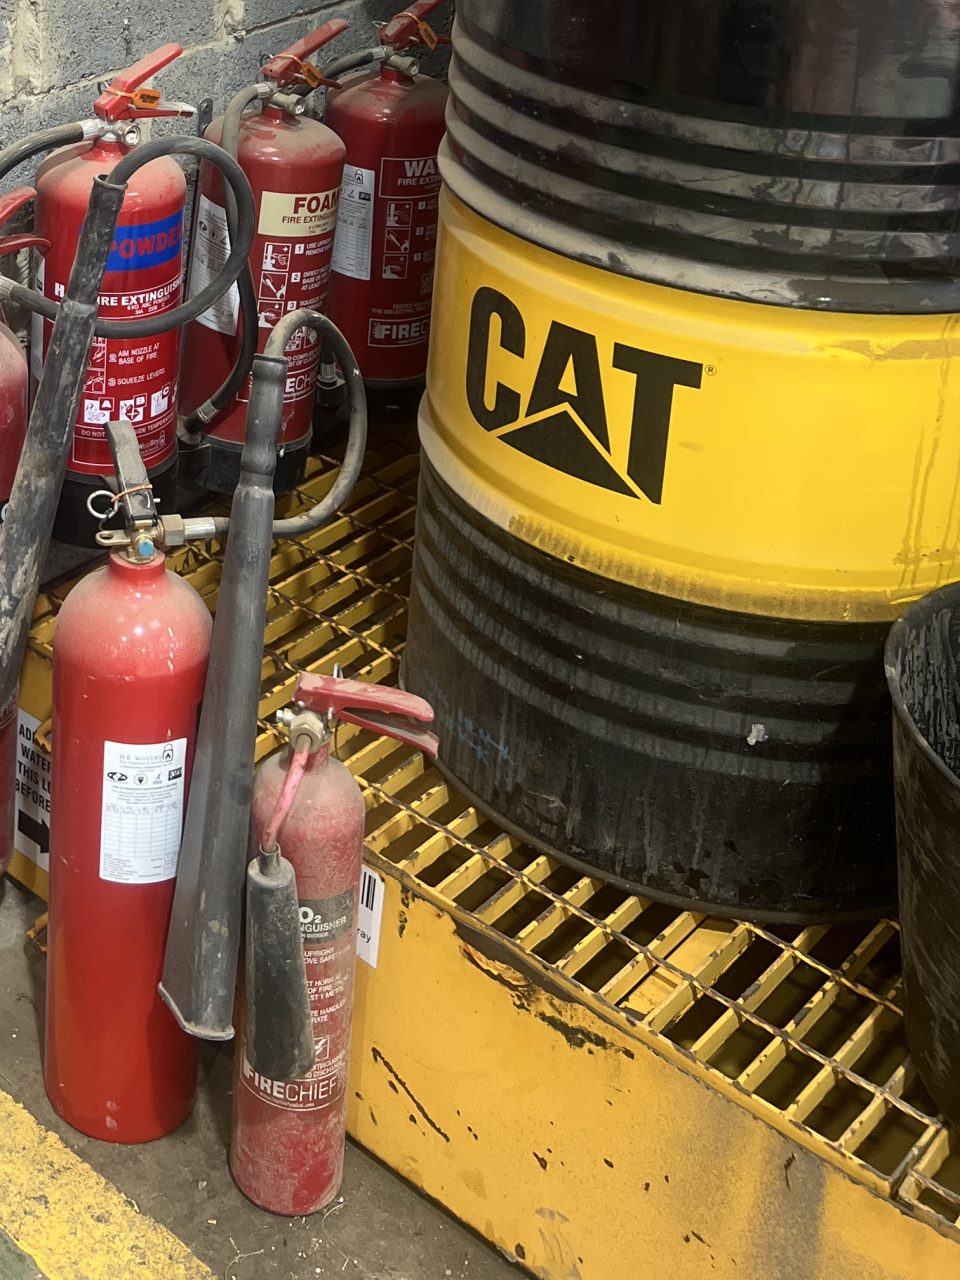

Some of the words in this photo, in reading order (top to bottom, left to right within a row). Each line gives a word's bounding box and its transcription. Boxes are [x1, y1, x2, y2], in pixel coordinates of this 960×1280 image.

[398, 177, 418, 186] FIRE
[282, 216, 302, 224] FIRE
[97, 296, 118, 306] IRE
[131, 345, 153, 355] NOZZLE
[153, 342, 160, 351] AT
[118, 356, 135, 365] BASE
[136, 355, 144, 363] OF
[117, 375, 145, 385] SQUEEZE
[146, 367, 166, 380] LEVERS
[465, 286, 703, 505] CAT
[18, 760, 40, 786] THIS
[304, 946, 335, 957] UPRIGHT
[243, 1054, 338, 1102] FIRECHIEF
